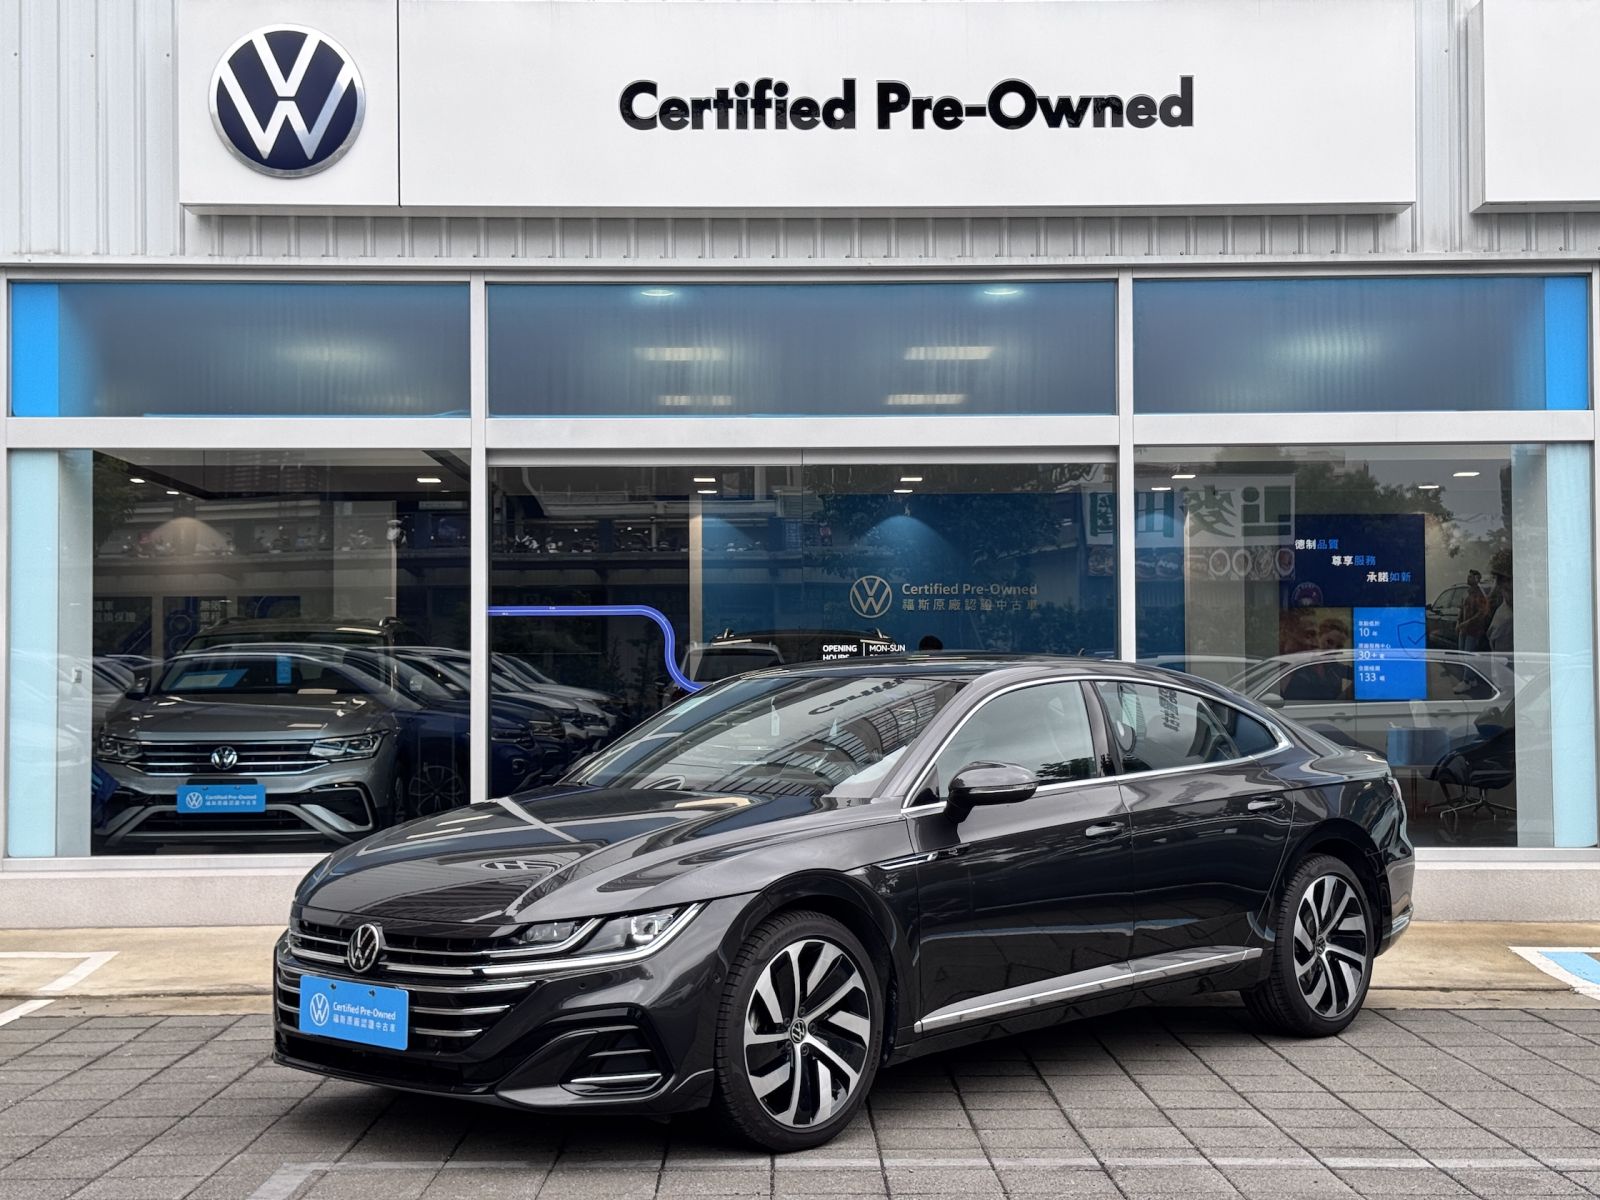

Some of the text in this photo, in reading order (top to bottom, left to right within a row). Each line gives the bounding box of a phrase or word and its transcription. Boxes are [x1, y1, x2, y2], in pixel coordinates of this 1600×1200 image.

[618, 75, 1195, 131] Certified Pre-Owned
[902, 583, 1038, 595] Certified Pre-Owned
[1359, 627, 1370, 637] 10
[822, 644, 906, 652] OPENING MON-SUN
[1359, 672, 1377, 682] 133
[333, 1001, 397, 1021] Certified Pre-Owned
